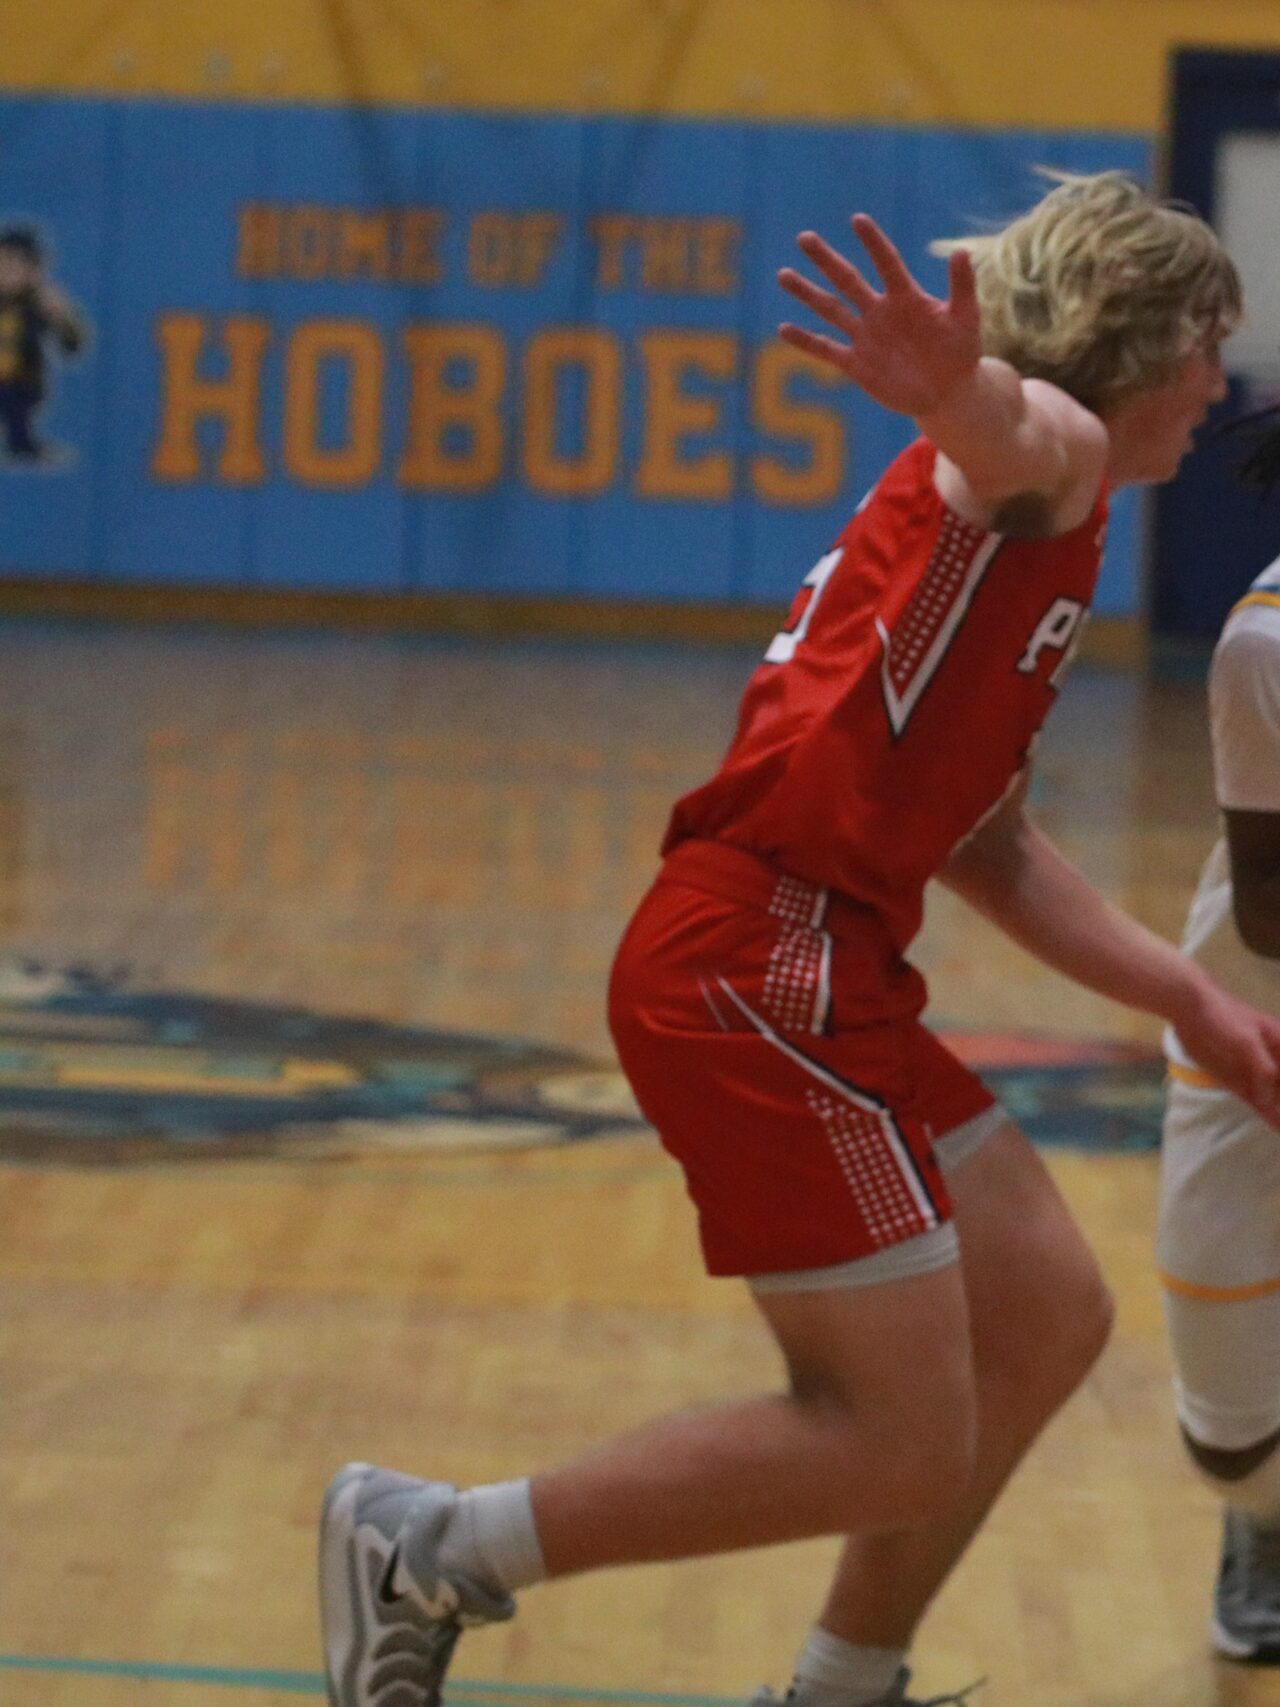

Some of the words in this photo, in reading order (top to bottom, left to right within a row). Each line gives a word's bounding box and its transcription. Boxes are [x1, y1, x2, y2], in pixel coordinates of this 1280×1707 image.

[237, 203, 444, 283] HOME
[467, 211, 562, 288] OF
[589, 215, 742, 295] THE
[152, 313, 848, 506] HOBOES
